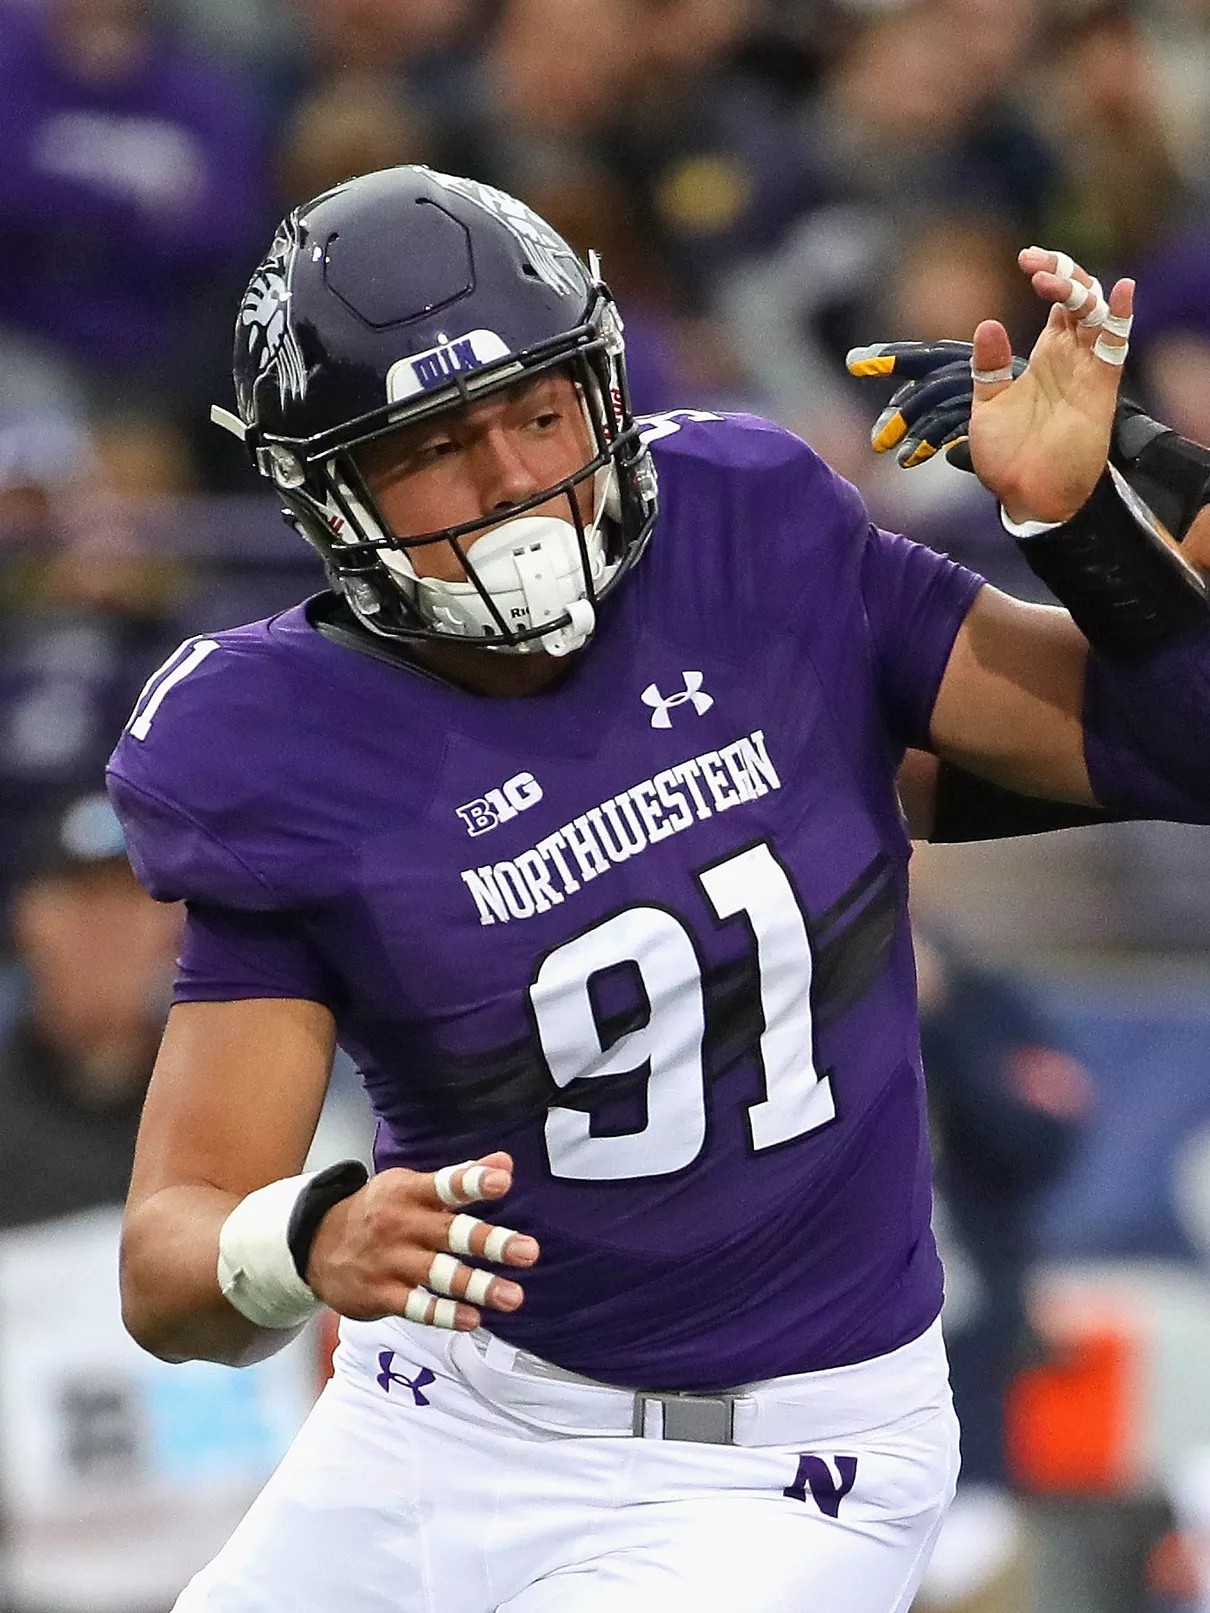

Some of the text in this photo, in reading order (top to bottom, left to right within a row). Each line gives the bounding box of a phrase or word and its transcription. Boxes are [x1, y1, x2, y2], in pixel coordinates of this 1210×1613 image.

[460, 729, 781, 925] NORTHWESTERN
[528, 840, 837, 1181] 91
[783, 1454, 858, 1519] N
